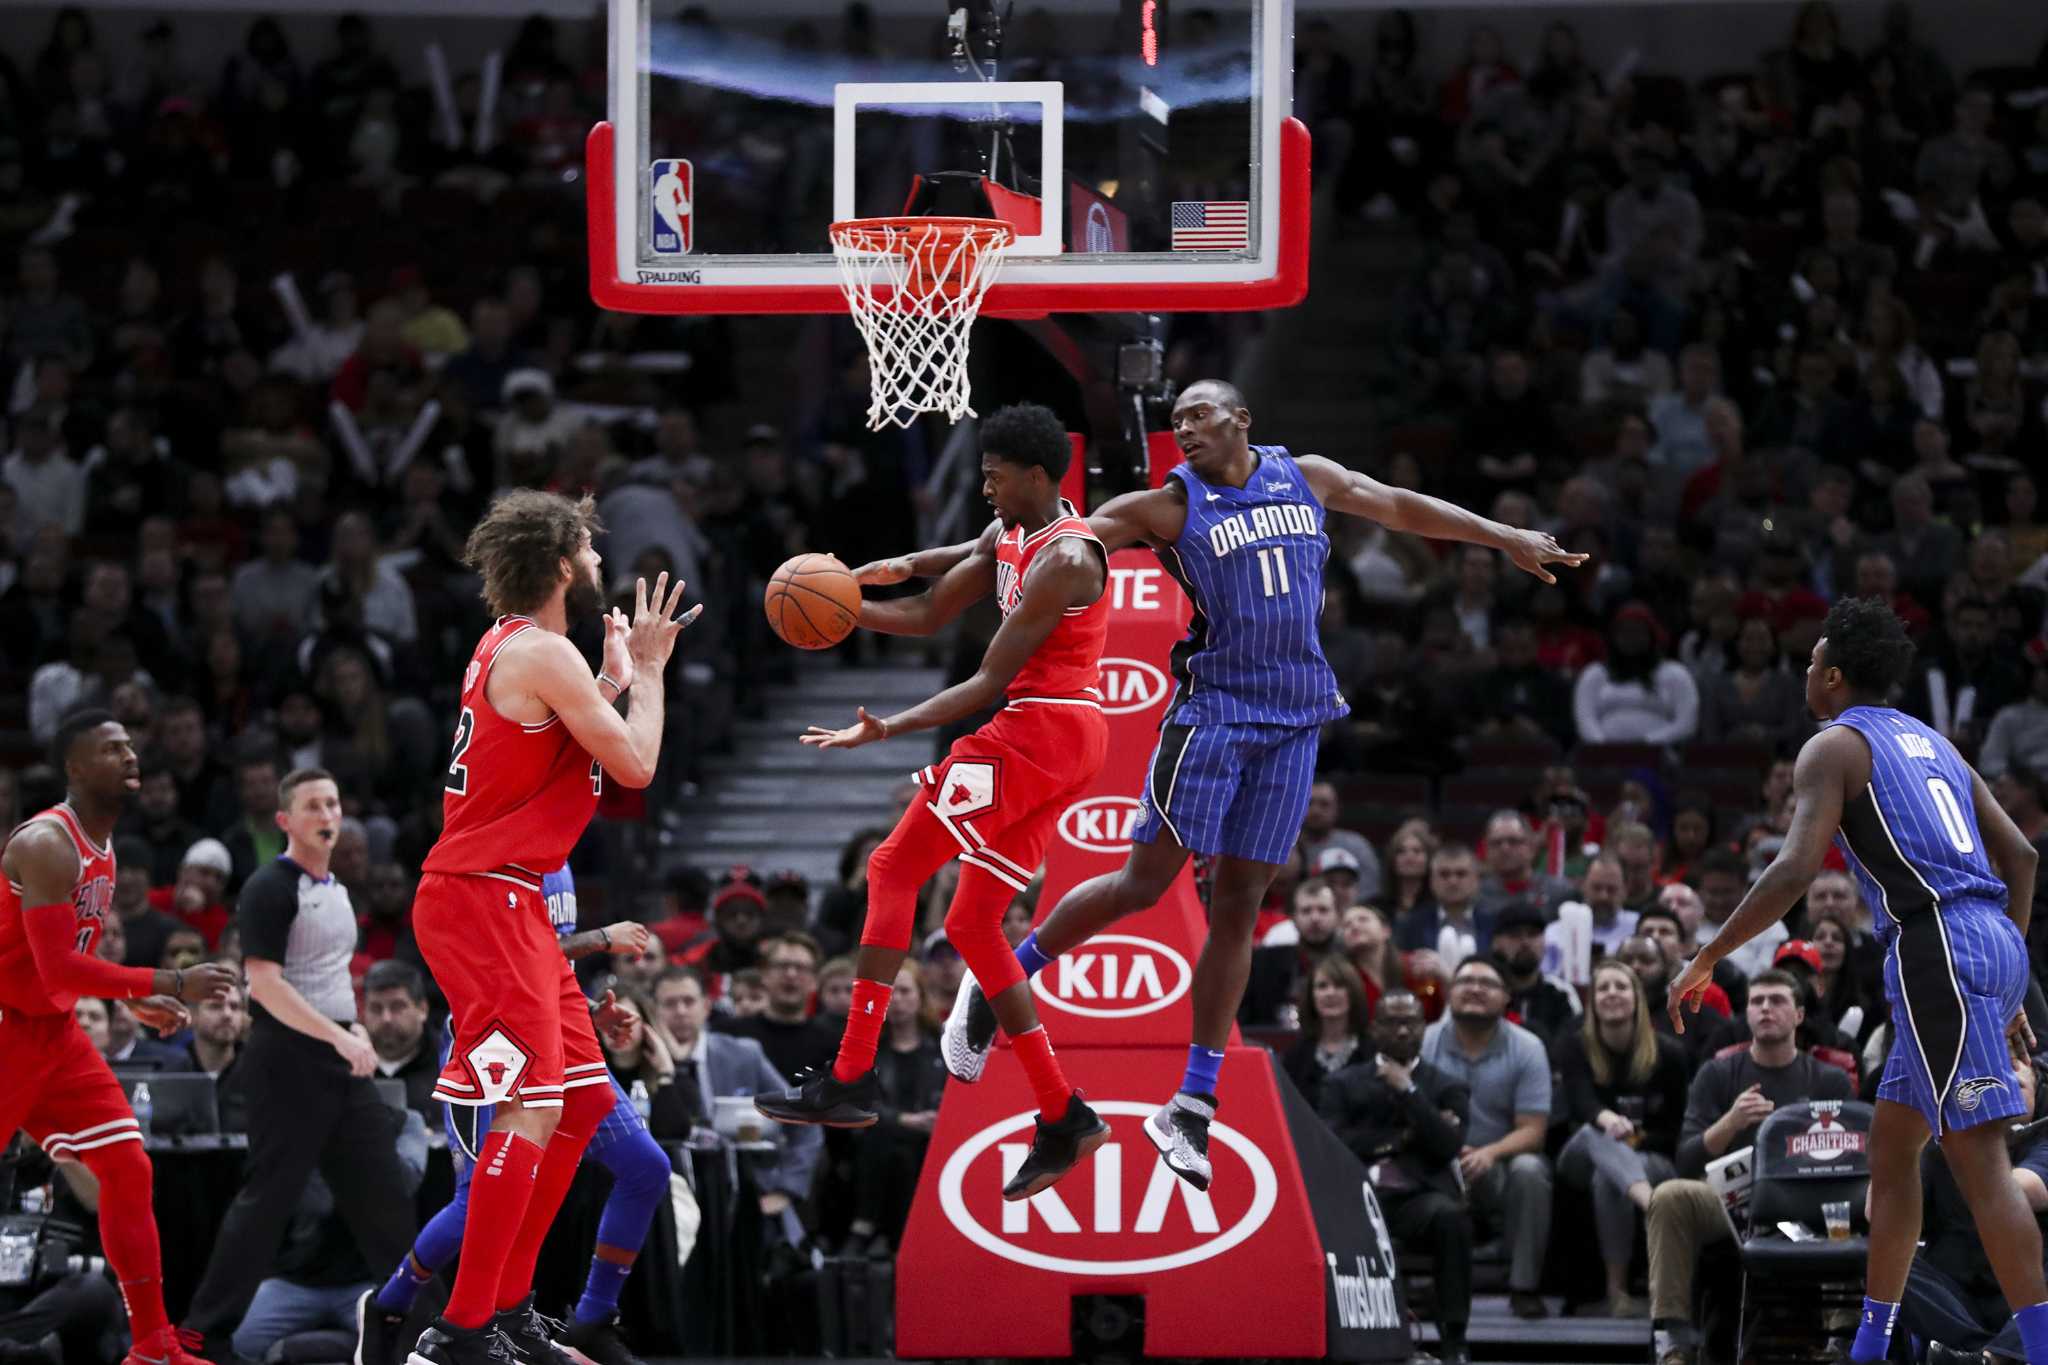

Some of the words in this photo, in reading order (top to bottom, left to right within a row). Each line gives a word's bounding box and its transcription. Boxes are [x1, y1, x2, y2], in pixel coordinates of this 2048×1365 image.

[637, 269, 702, 285] SPALDING
[1209, 504, 1317, 558] ORLANDO
[1108, 568, 1162, 610] TE
[1256, 546, 1290, 597] 11
[1098, 670, 1150, 702] IA
[1926, 778, 1975, 854] 0
[1058, 954, 1165, 999] KIA
[1792, 1132, 1859, 1154] CHARITIES
[998, 1142, 1221, 1234] KIA
[1326, 1252, 1401, 1329] TransUnion
